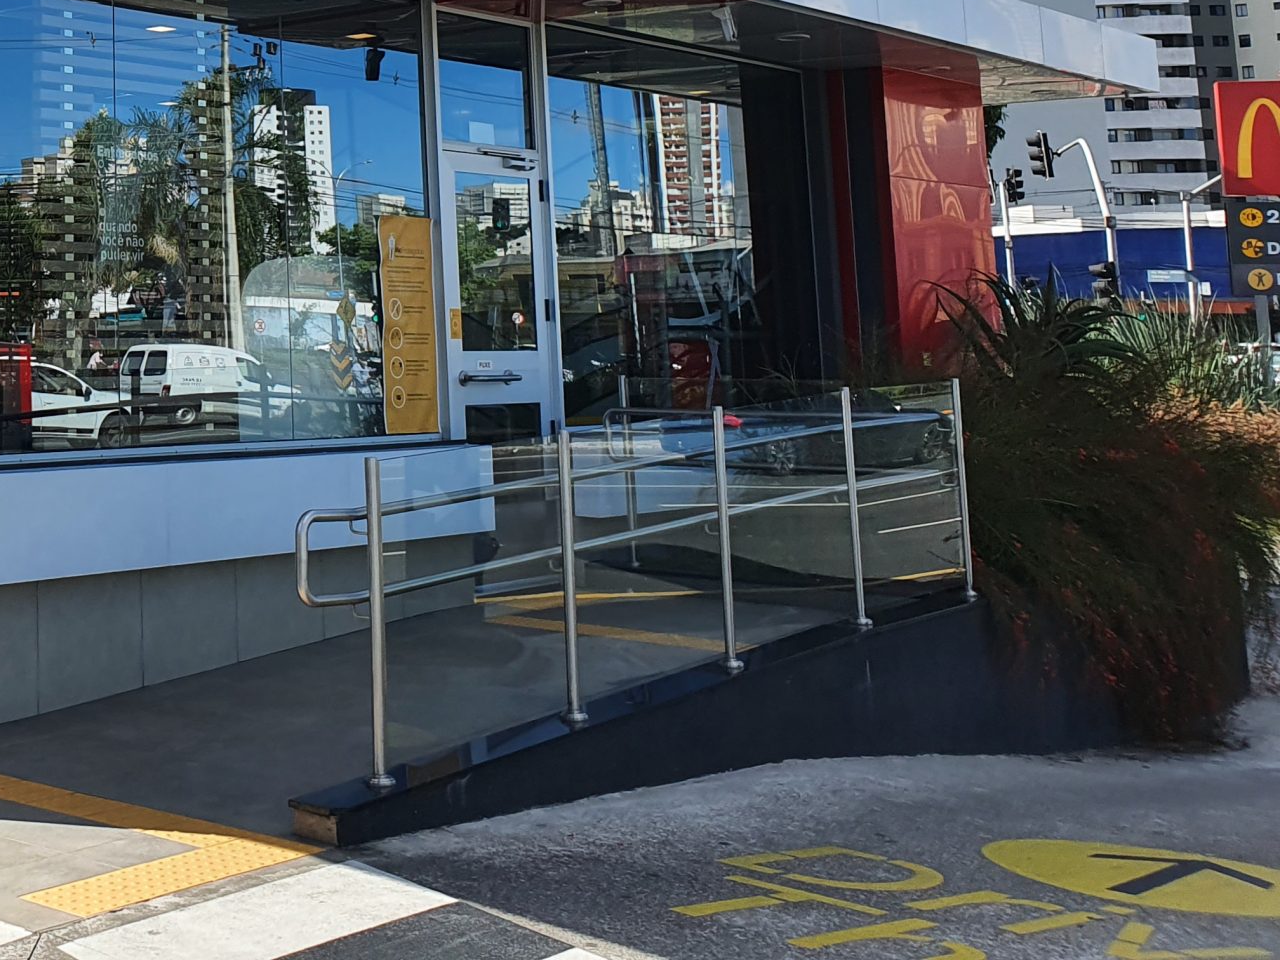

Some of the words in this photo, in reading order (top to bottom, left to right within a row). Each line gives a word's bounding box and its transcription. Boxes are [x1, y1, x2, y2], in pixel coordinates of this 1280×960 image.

[99, 235, 124, 247] você
[126, 234, 145, 248] não
[132, 247, 145, 261] vir
